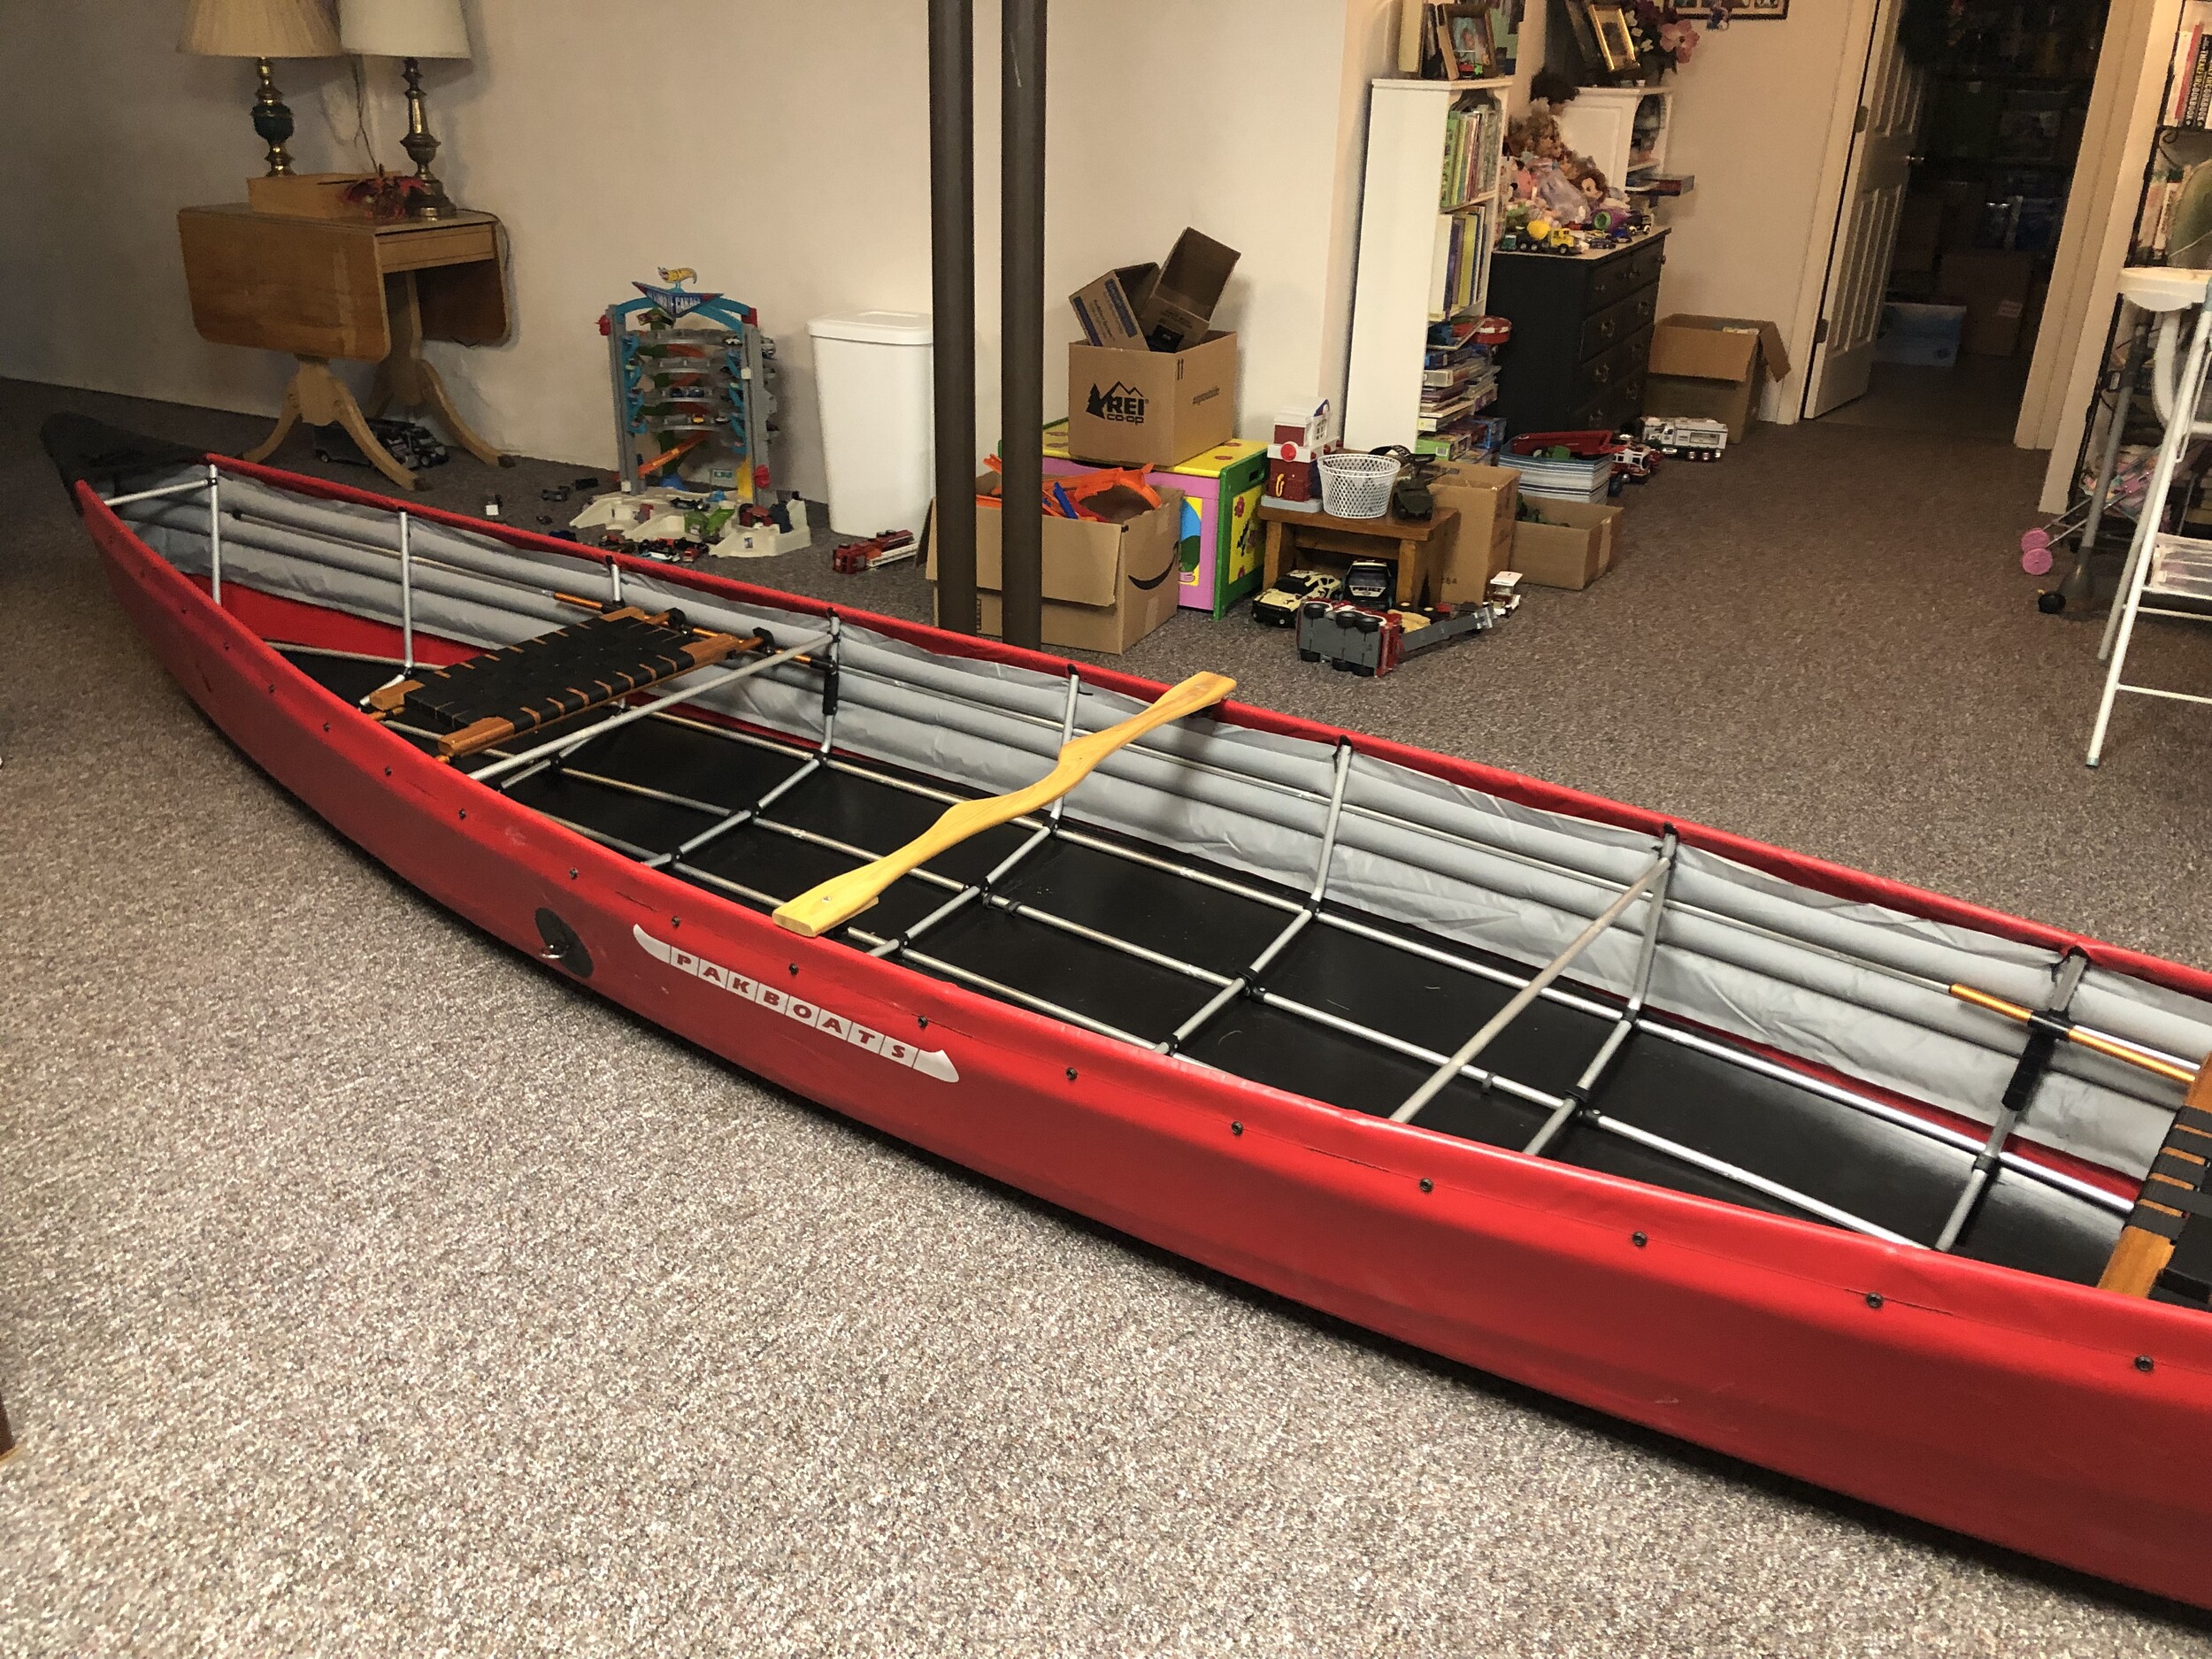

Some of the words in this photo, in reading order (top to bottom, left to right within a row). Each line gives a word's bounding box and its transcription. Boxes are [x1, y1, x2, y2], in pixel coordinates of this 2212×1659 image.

[2185, 83, 2201, 120] COOKBOOK
[1107, 396, 1145, 416] REI
[677, 953, 906, 1059] PAKBOATS
